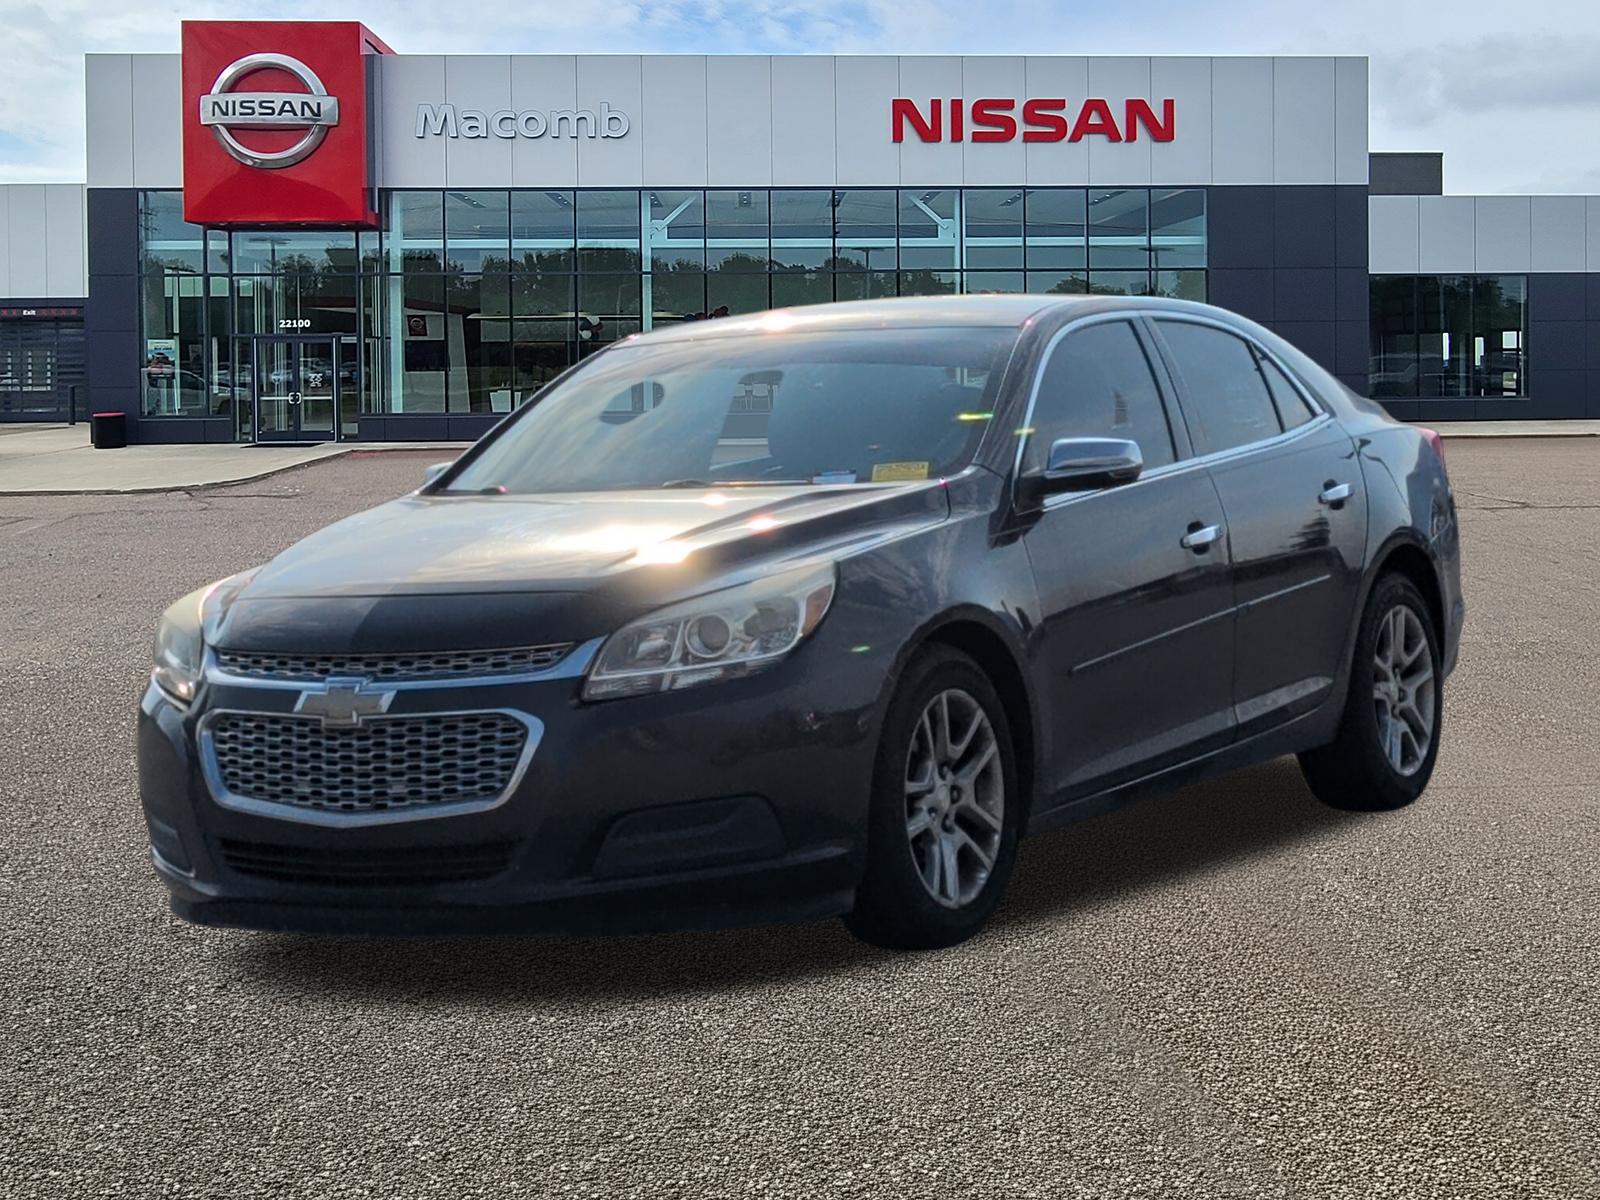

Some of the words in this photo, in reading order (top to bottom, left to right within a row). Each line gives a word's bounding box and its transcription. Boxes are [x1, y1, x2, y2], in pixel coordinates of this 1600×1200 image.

[212, 100, 321, 117] NISSAN
[415, 101, 630, 139] Macomb
[892, 98, 1175, 143] NISSAN
[279, 319, 311, 328] 22100
